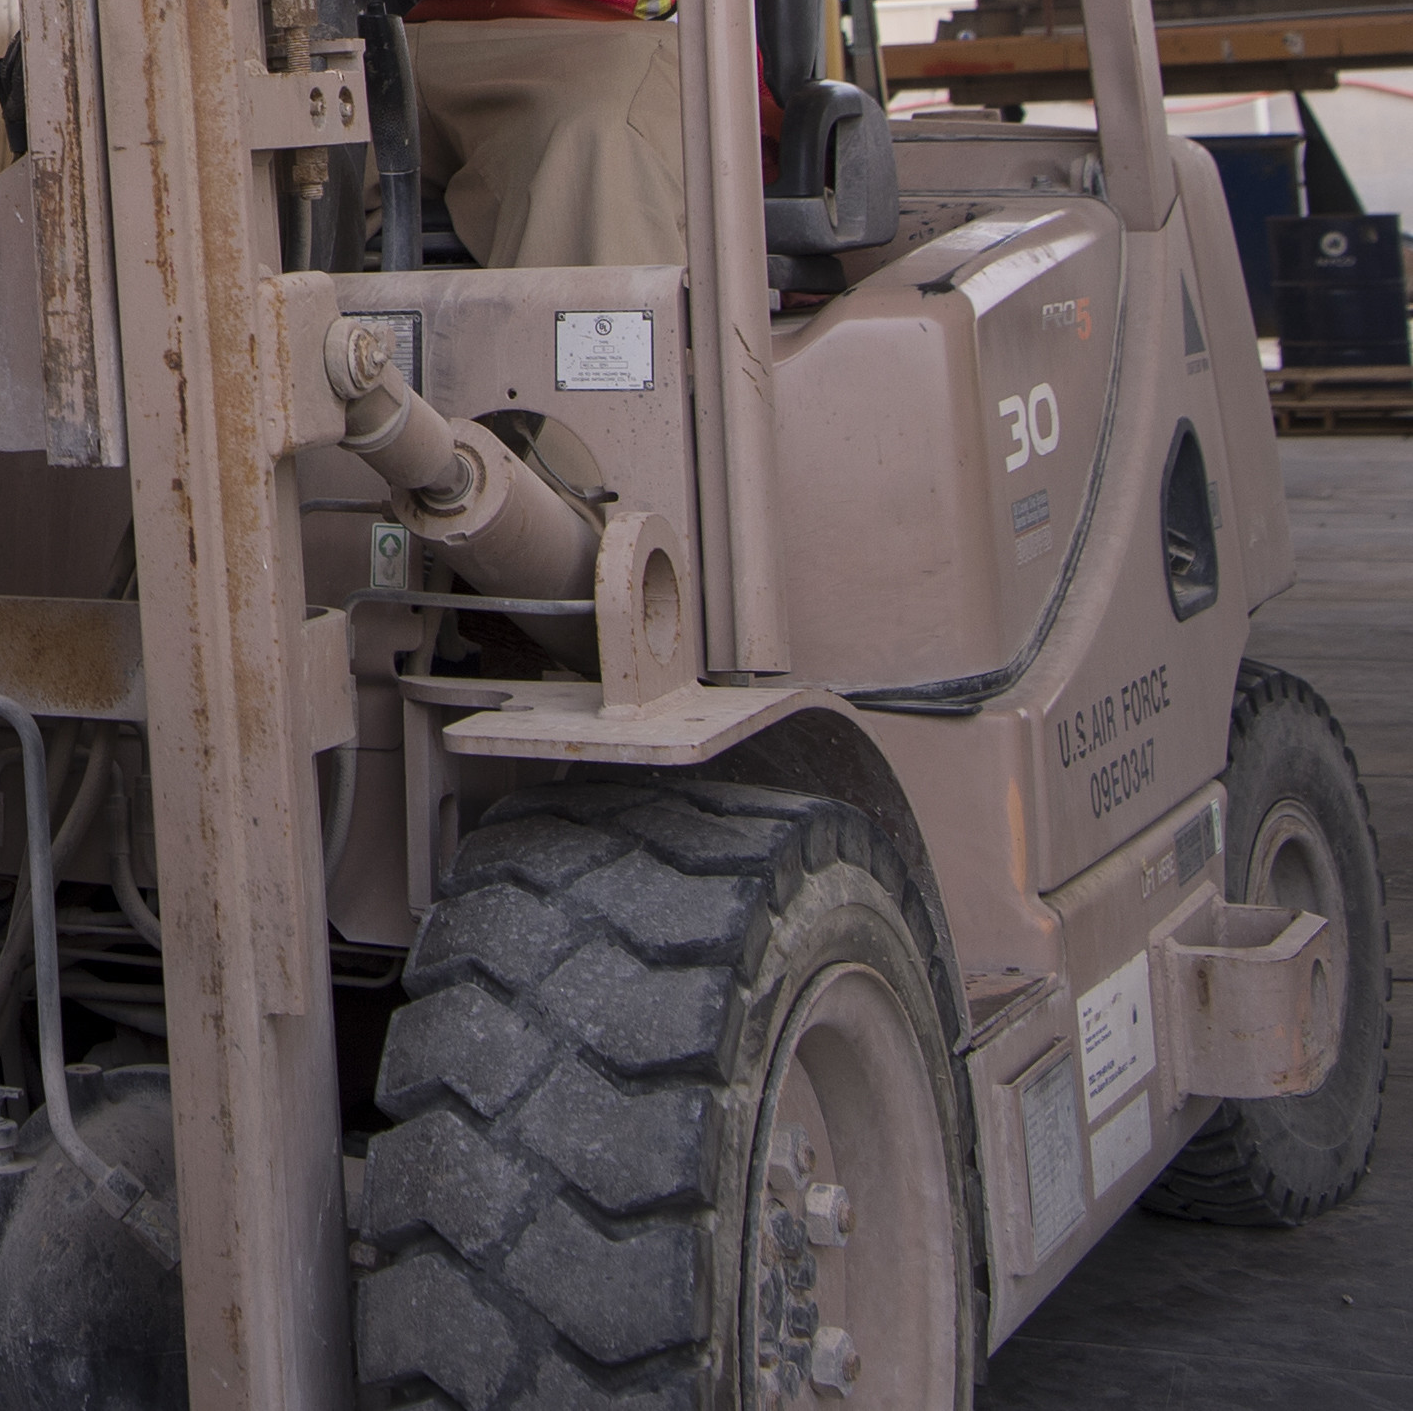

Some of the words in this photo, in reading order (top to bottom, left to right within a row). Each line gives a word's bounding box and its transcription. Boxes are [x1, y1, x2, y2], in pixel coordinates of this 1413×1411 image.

[998, 382, 1060, 474] 30
[1121, 664, 1171, 732] FORCE
[1090, 737, 1155, 820] 09E0347
